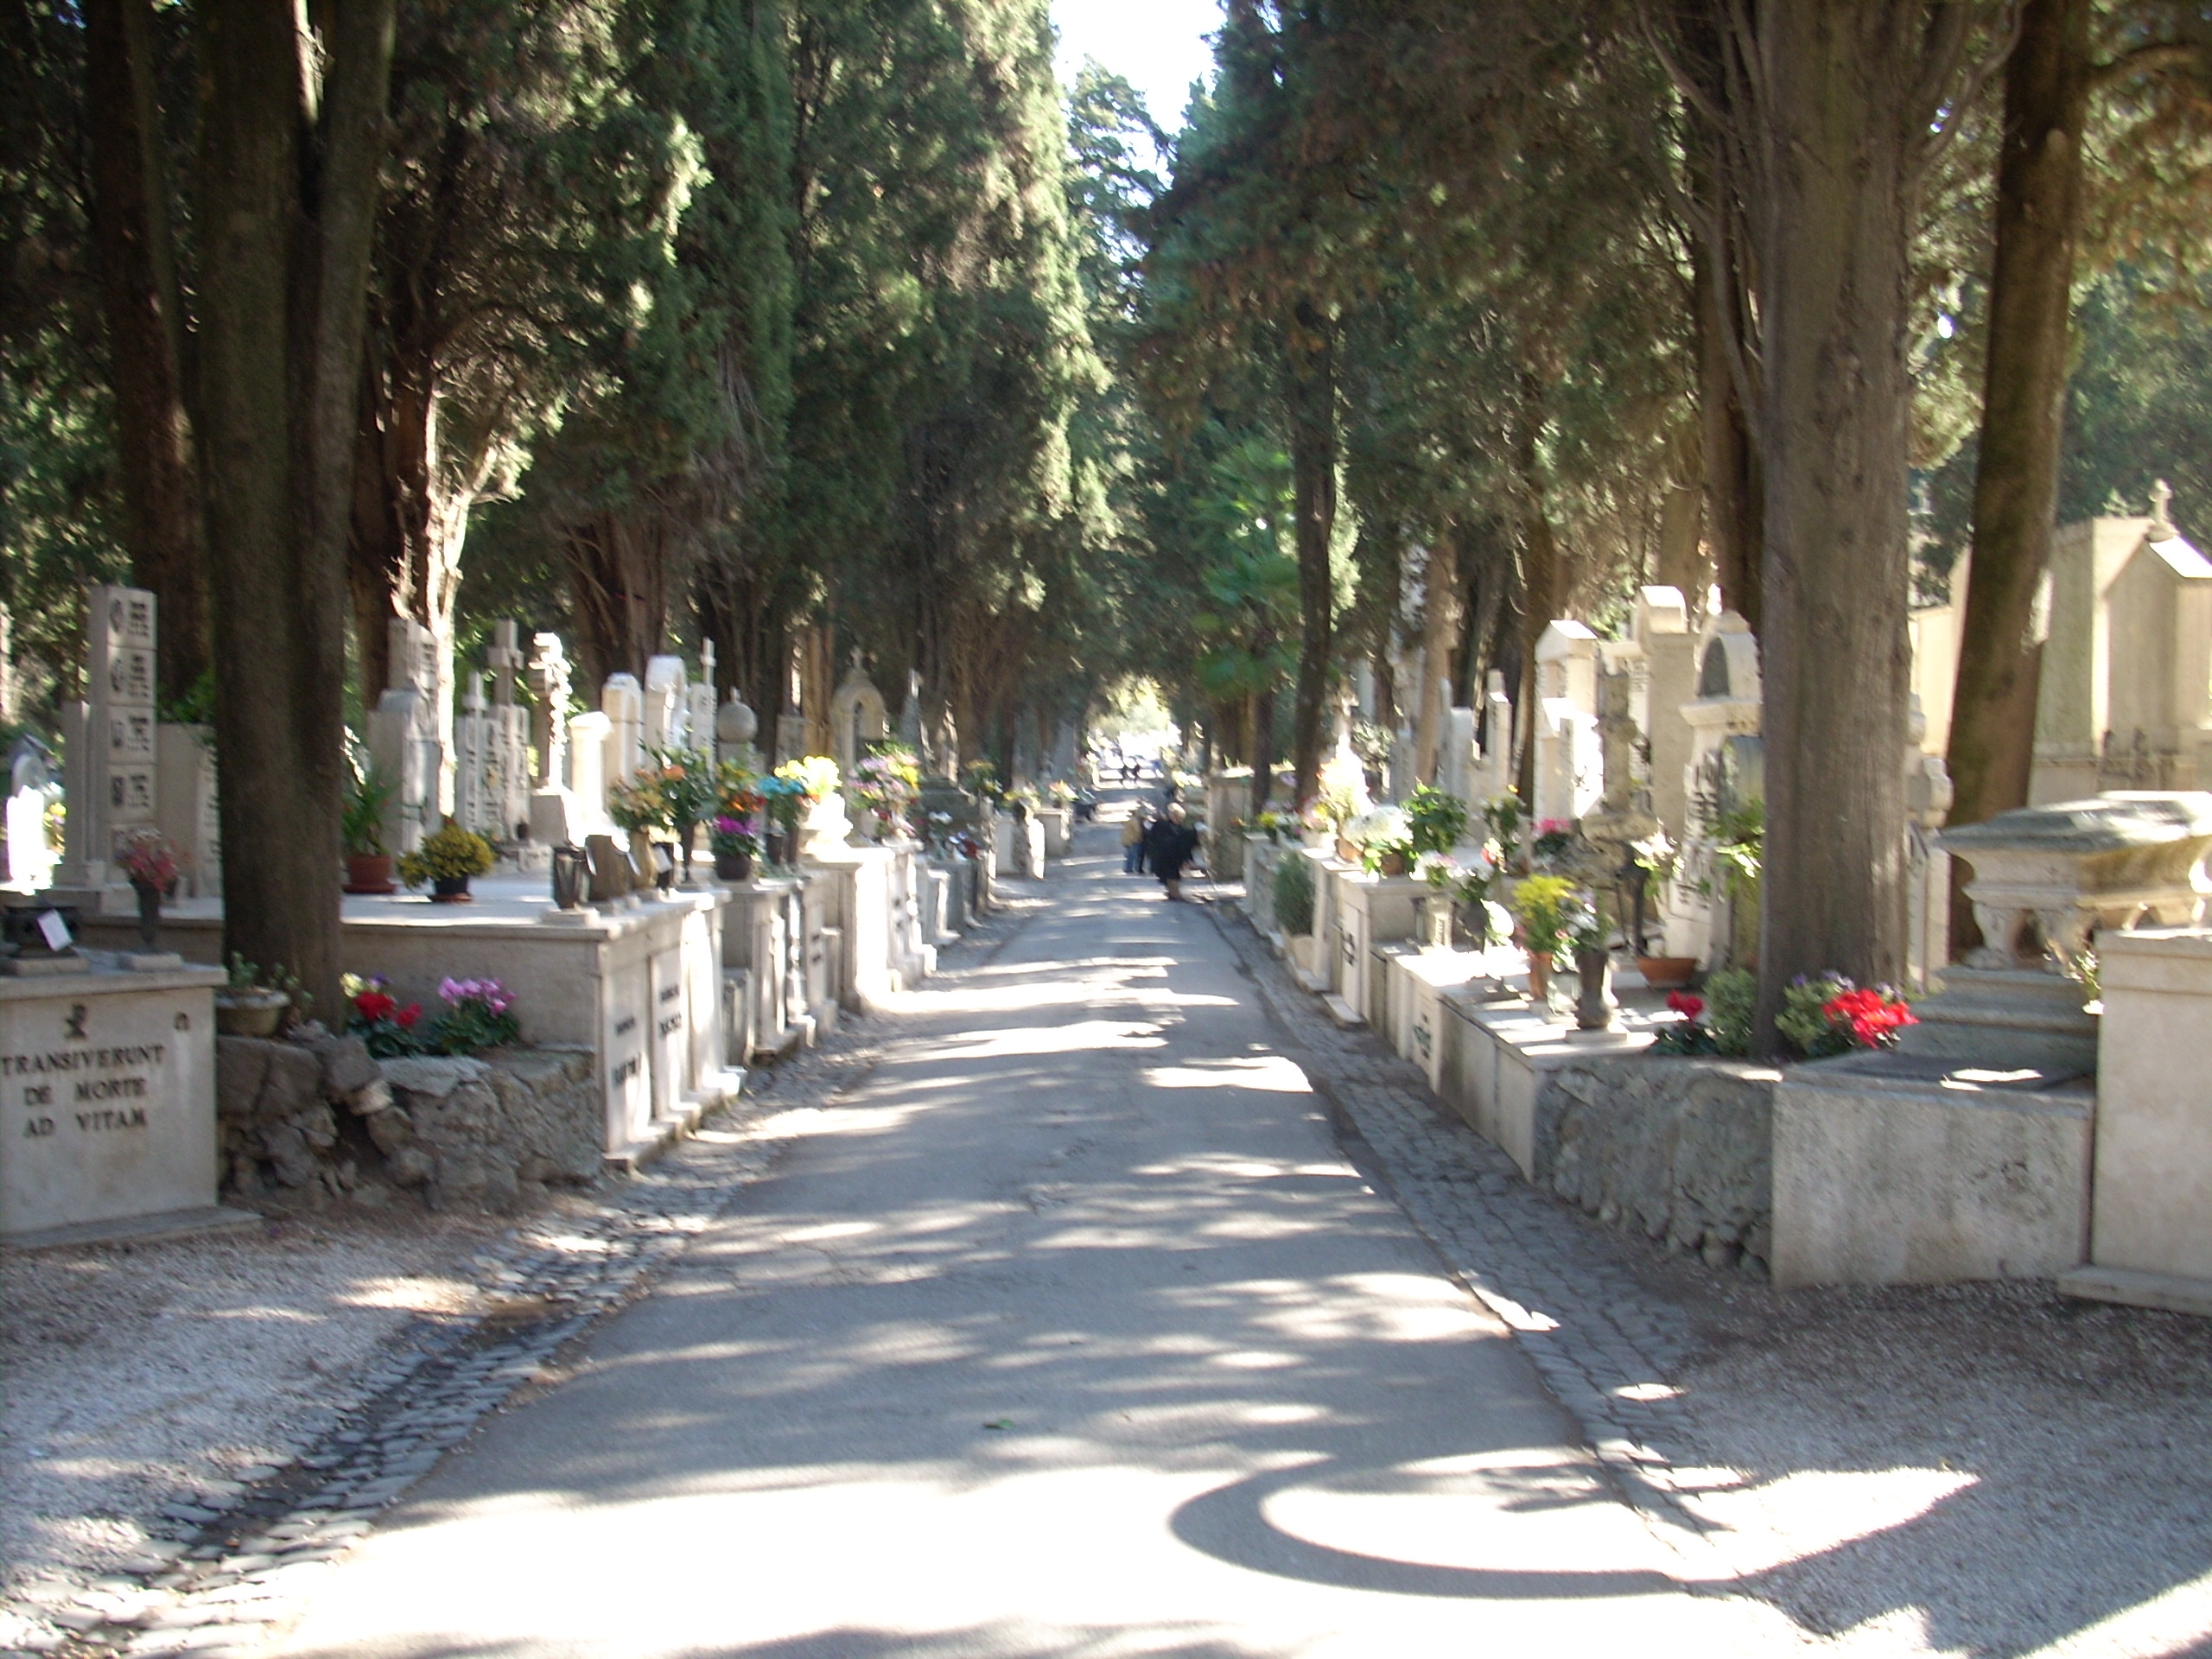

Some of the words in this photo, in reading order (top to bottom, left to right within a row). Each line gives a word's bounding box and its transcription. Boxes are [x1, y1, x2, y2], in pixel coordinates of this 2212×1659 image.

[2, 1044, 164, 1076] TRANSIVERUNT
[23, 1085, 53, 1106] DE
[74, 1077, 146, 1102] MORTE
[24, 1117, 55, 1137] AD
[75, 1108, 147, 1131] VITAM
